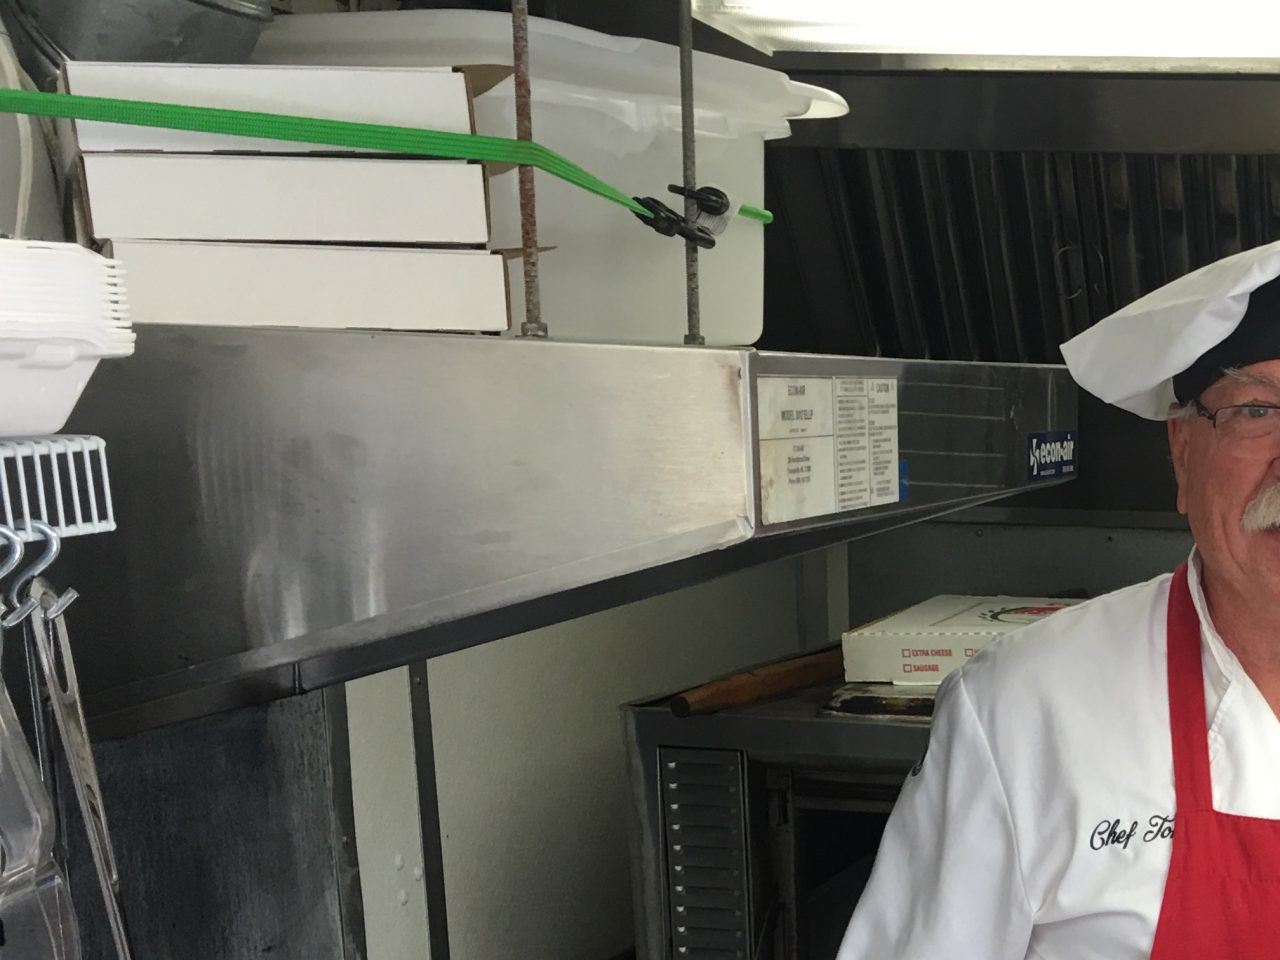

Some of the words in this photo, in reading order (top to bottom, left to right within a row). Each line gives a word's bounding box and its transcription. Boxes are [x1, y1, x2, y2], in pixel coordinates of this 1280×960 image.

[1040, 433, 1075, 464] econ-air
[911, 649, 930, 657] EXTRA
[930, 649, 953, 657] CHEESE
[912, 664, 940, 672] SAUSAGE
[1089, 818, 1139, 851] Chef
[1143, 814, 1176, 843] To
